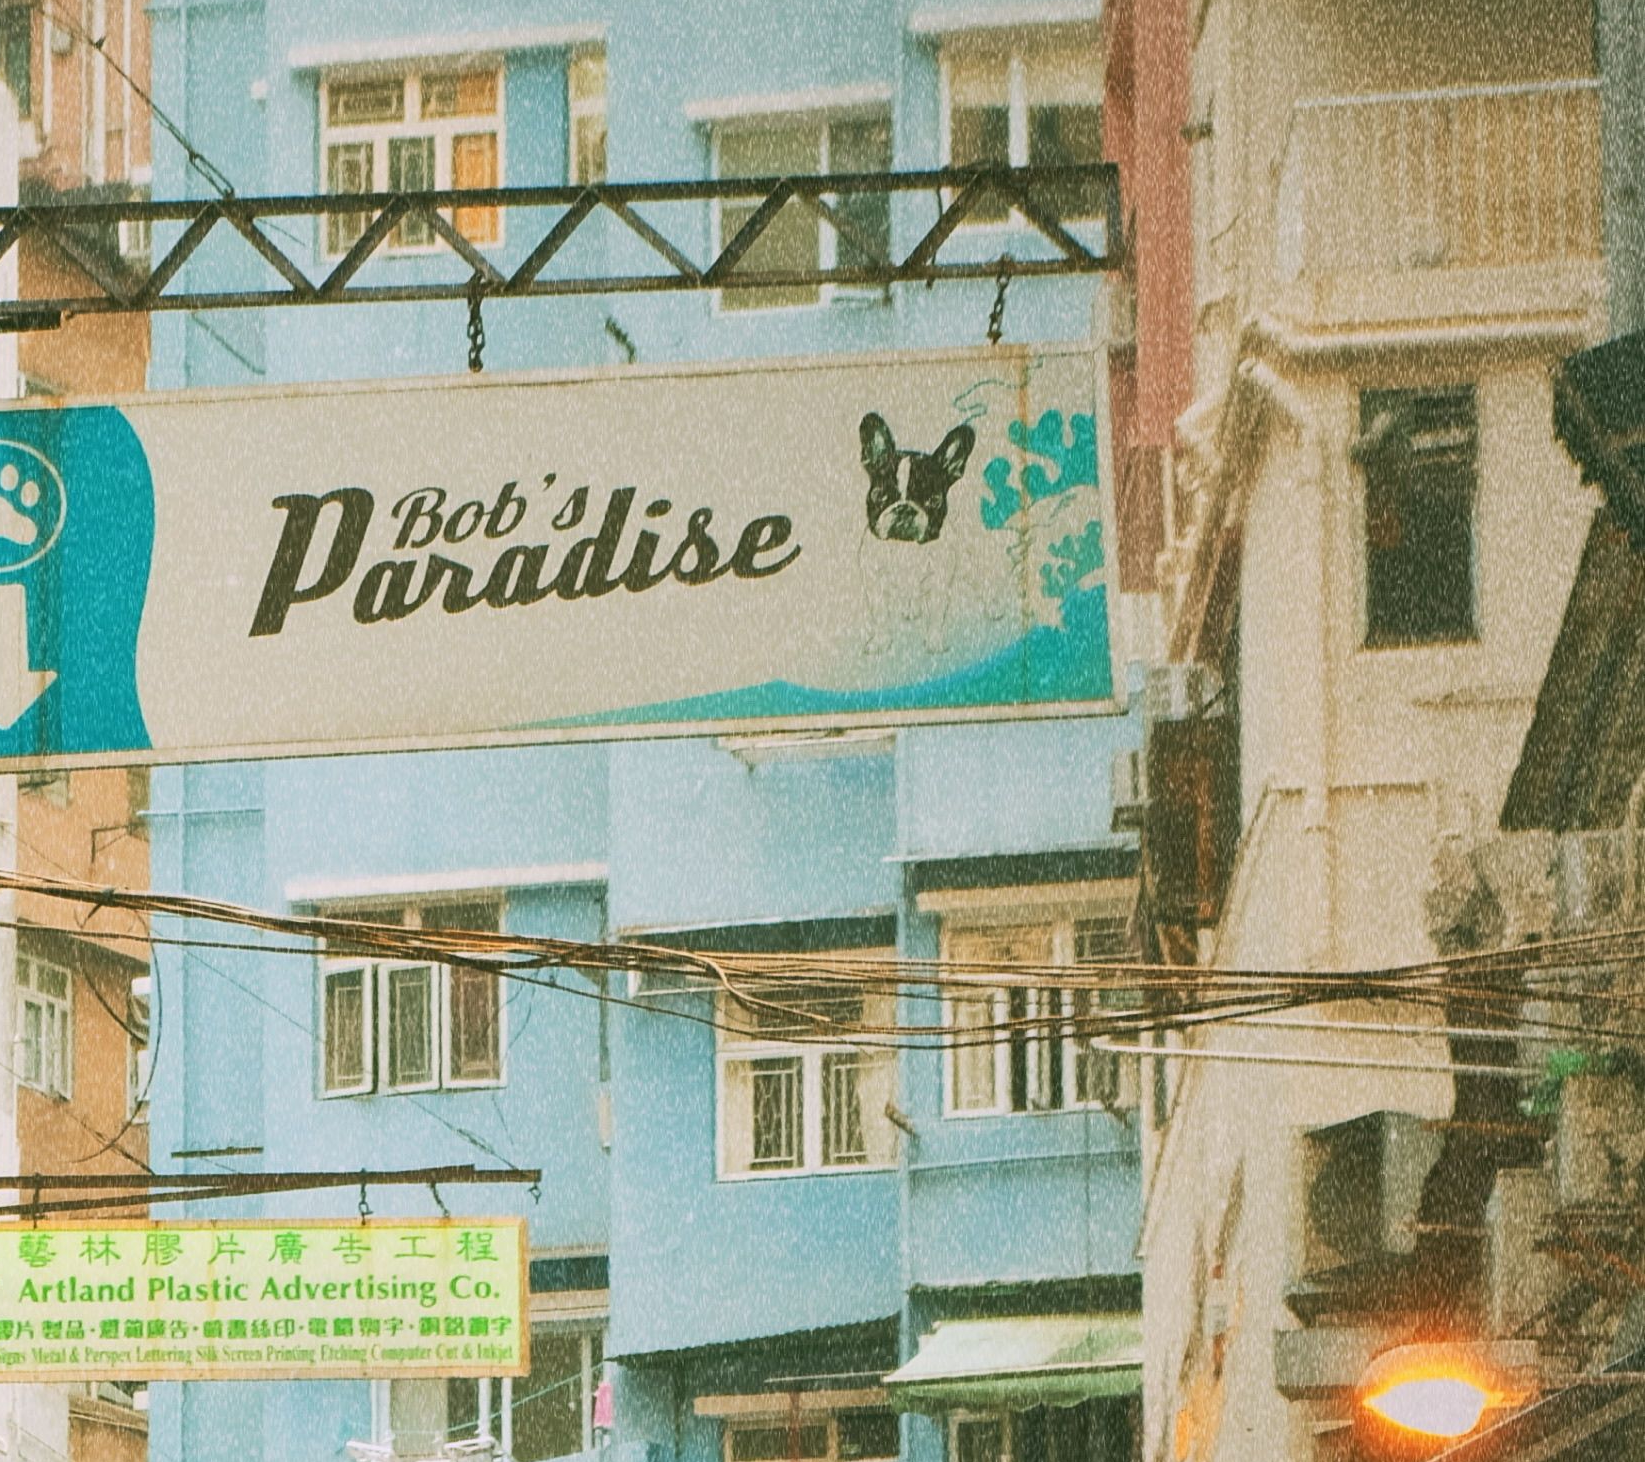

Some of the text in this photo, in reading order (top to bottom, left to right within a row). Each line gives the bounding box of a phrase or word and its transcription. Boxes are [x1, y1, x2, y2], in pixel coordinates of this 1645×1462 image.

[391, 473, 590, 549] Bob's
[248, 486, 802, 638] Paradise
[18, 1231, 499, 1268] 藝林膠片廣告工程
[19, 1275, 500, 1307] Artland Plastic Advertising Co.
[69, 1346, 79, 1363] &
[223, 1345, 262, 1362] Screen
[267, 1345, 314, 1365] Printing
[462, 1343, 473, 1359] &
